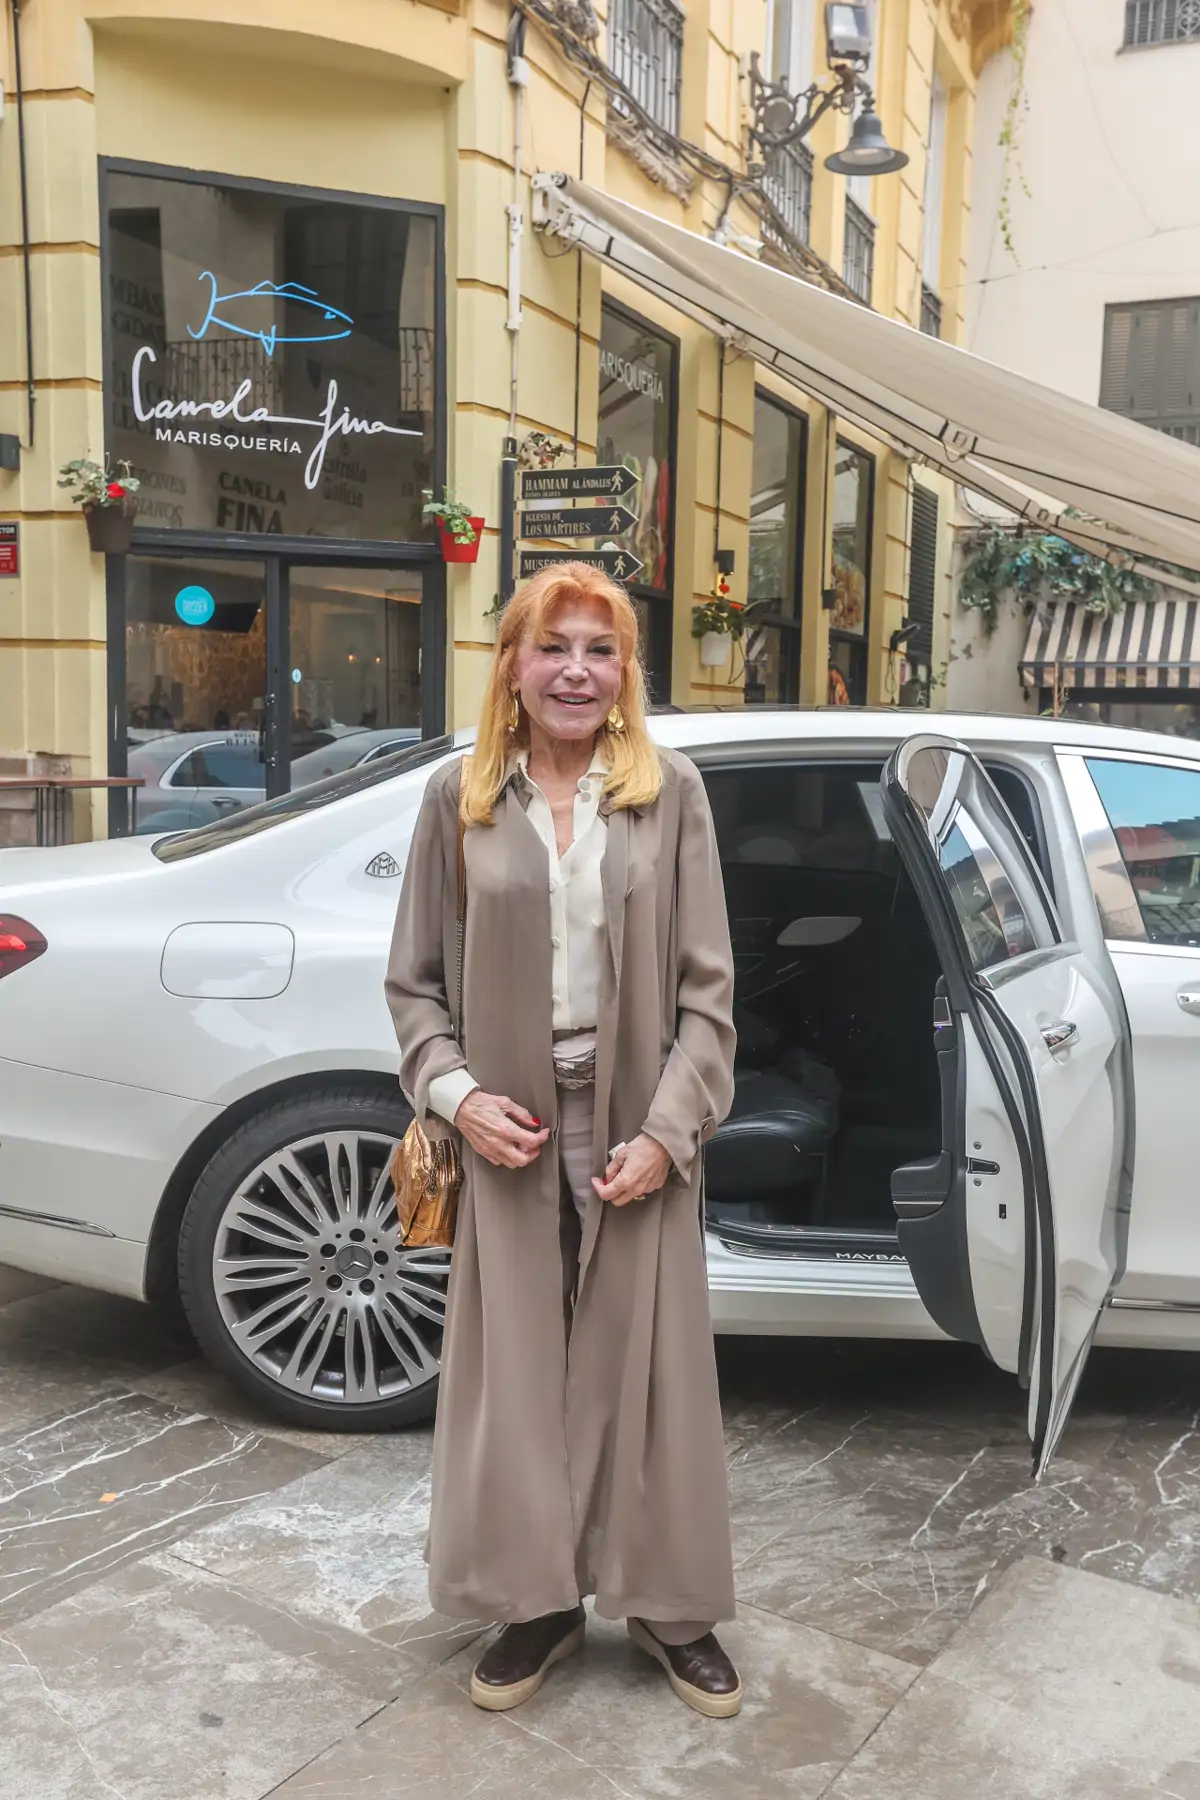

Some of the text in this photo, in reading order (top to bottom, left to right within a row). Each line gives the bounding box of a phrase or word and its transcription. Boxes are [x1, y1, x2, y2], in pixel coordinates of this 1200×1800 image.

[131, 346, 322, 424] Canela
[600, 350, 664, 404] ARISQUERÍA
[155, 428, 301, 454] MARISQUERÍA
[219, 471, 287, 506] CANELA
[525, 478, 568, 491] HAMMAM
[216, 497, 283, 535] FINA
[525, 524, 543, 536] LOS
[552, 512, 562, 521] DE
